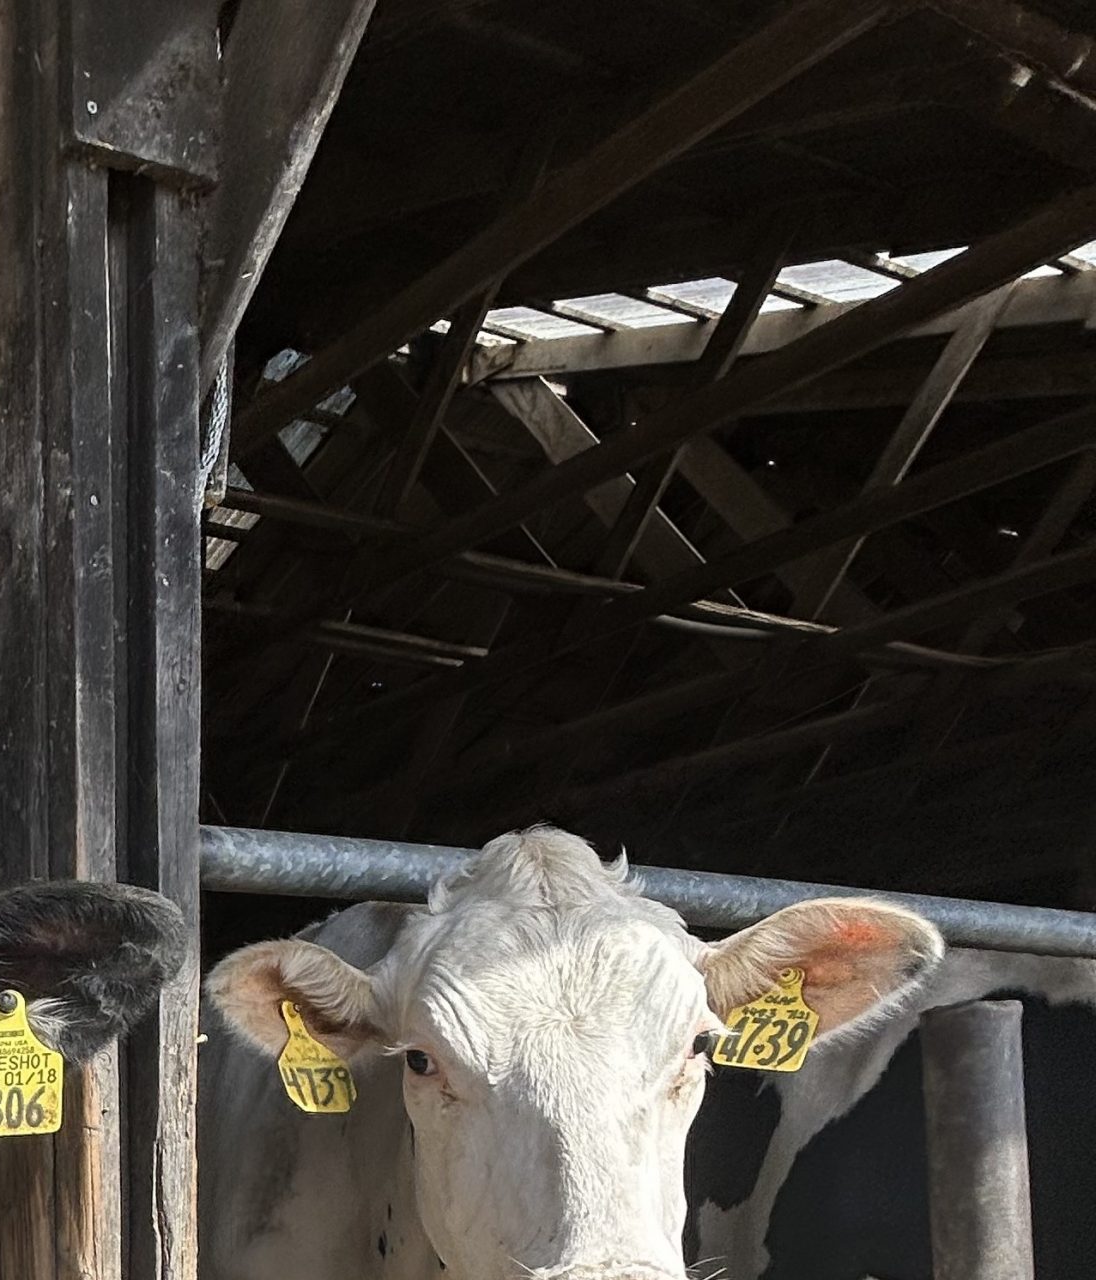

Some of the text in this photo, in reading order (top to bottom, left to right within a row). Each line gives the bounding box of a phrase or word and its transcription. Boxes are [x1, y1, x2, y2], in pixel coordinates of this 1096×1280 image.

[718, 1016, 809, 1068] 4739
[4, 1068, 57, 1085] 01/18
[283, 1067, 353, 1107] 4739
